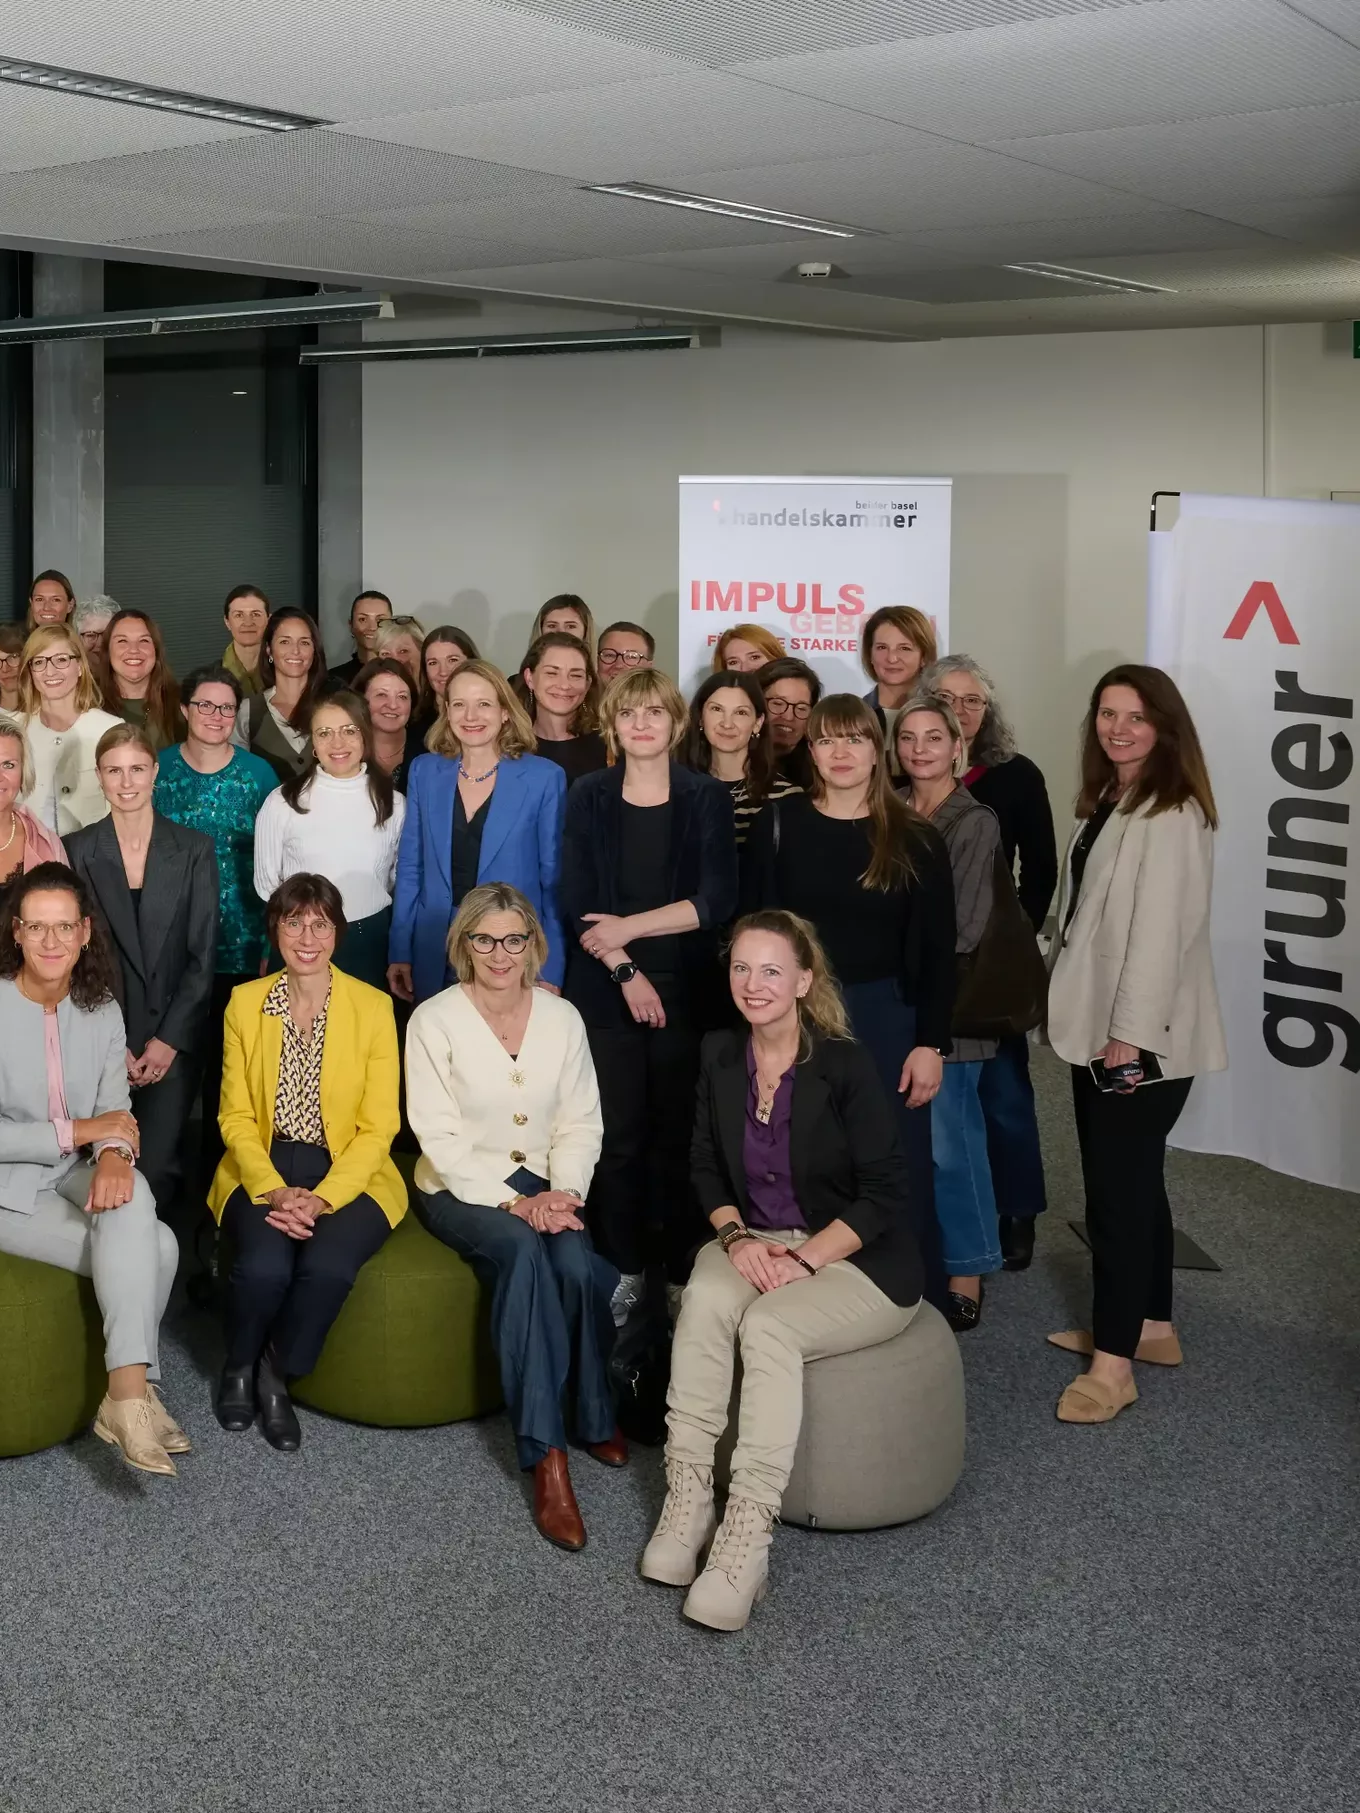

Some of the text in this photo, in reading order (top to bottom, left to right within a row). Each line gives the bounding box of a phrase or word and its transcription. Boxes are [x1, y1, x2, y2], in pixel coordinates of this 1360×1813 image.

[891, 500, 918, 510] basel
[691, 580, 865, 615] IMPULS
[790, 611, 937, 637] GEB
[790, 637, 858, 652] STARKE
[1263, 670, 1360, 1074] gruner
